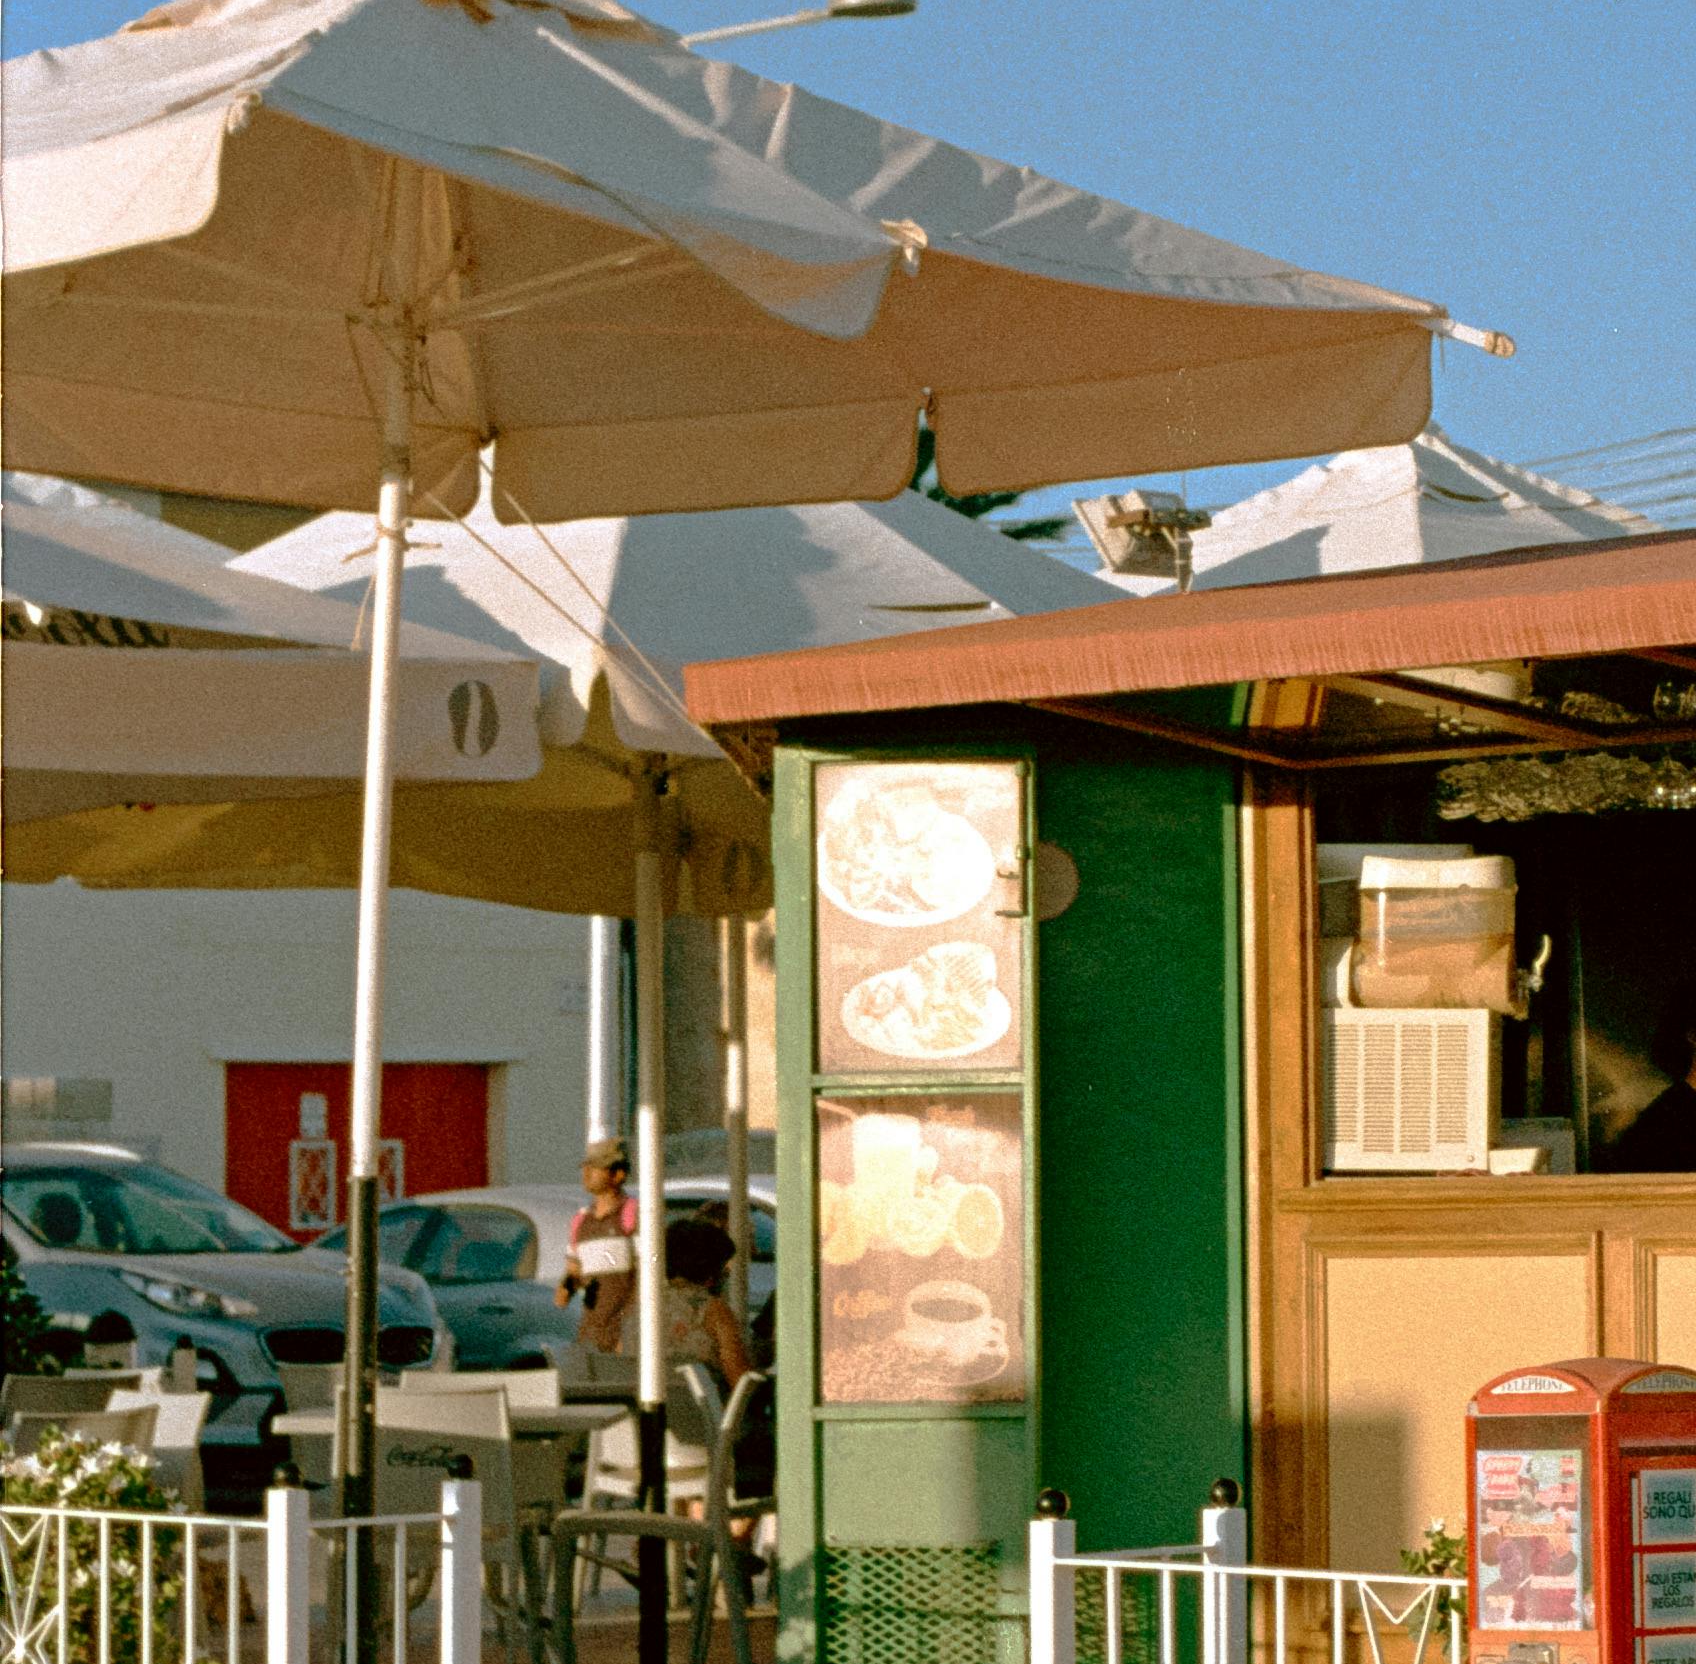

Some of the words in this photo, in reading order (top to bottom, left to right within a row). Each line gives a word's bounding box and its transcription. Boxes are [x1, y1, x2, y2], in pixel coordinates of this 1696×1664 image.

[1653, 1490, 1692, 1505] REGALI
[1643, 1505, 1676, 1519] SONO
[1663, 1585, 1681, 1596] LOS
[1651, 1596, 1695, 1609] REGALOS
